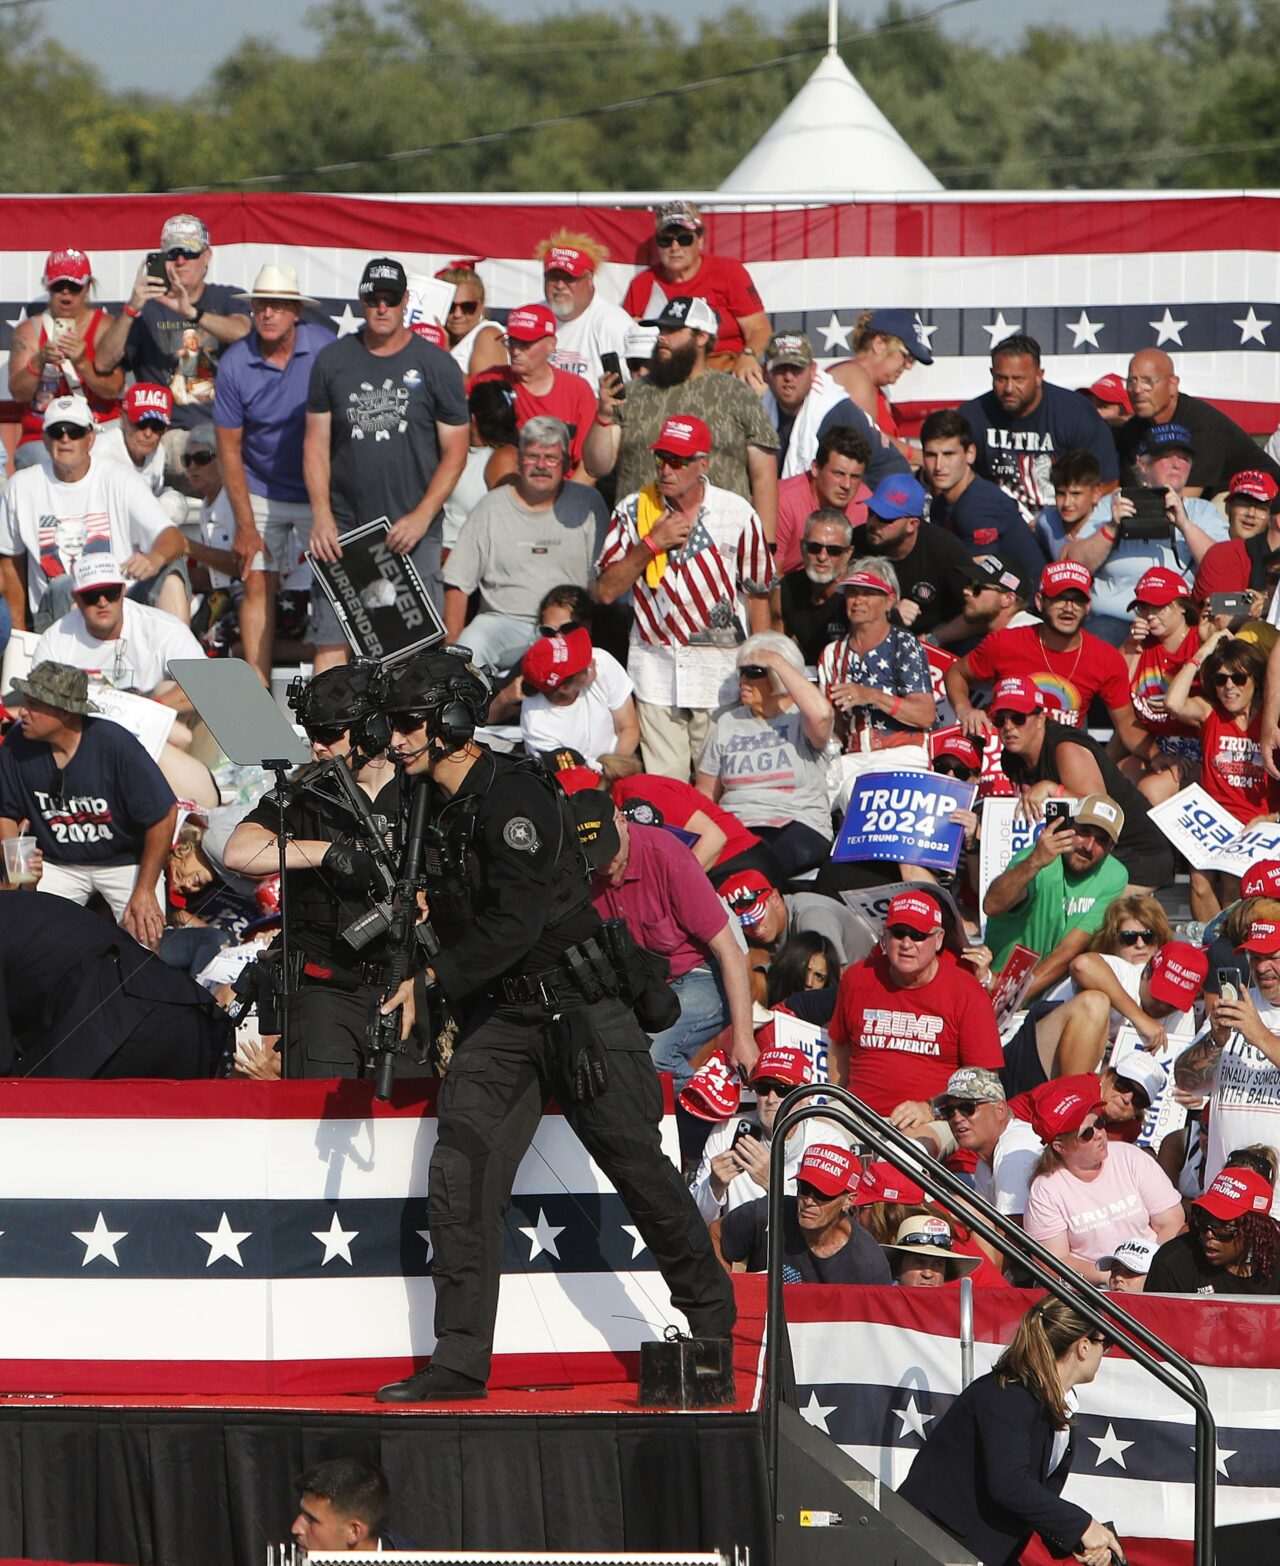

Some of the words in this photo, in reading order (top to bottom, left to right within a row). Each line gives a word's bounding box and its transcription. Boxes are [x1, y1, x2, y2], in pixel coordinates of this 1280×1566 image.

[134, 389, 168, 409] MAGA
[986, 427, 1055, 452] ULTRA
[1047, 563, 1068, 577] MAKE
[1051, 572, 1070, 584] GREAT
[368, 541, 424, 630] NEVER
[327, 560, 384, 659] URRENDER
[1051, 707, 1080, 728] THE
[722, 748, 793, 775] MAGA
[1228, 774, 1255, 788] 2024
[859, 788, 958, 817] TRUMP
[50, 822, 114, 844] 2024
[861, 809, 936, 838] 2024
[530, 841, 541, 854] CAT
[847, 834, 867, 845] TEXT
[868, 834, 899, 843] TRUMP
[901, 835, 916, 846] TO
[917, 839, 950, 852] 88022
[906, 898, 930, 911] AMERICA
[1251, 922, 1276, 934] Trump
[1166, 958, 1183, 975] MAKE
[862, 1008, 944, 1042] TRUMP
[860, 1034, 886, 1049] SAVE
[886, 1038, 941, 1056] AMERICA
[762, 1051, 796, 1062] TRUMP
[1220, 1064, 1252, 1084] FINALLY
[803, 1157, 822, 1170] GREAT
[821, 1161, 843, 1178] AGAIN
[805, 1145, 822, 1159] MAKE
[821, 1148, 850, 1170] AMERICA
[1211, 1182, 1242, 1200] TRUMP
[1216, 1173, 1248, 1191] MARYLAND
[1070, 1194, 1137, 1227] TRUMP
